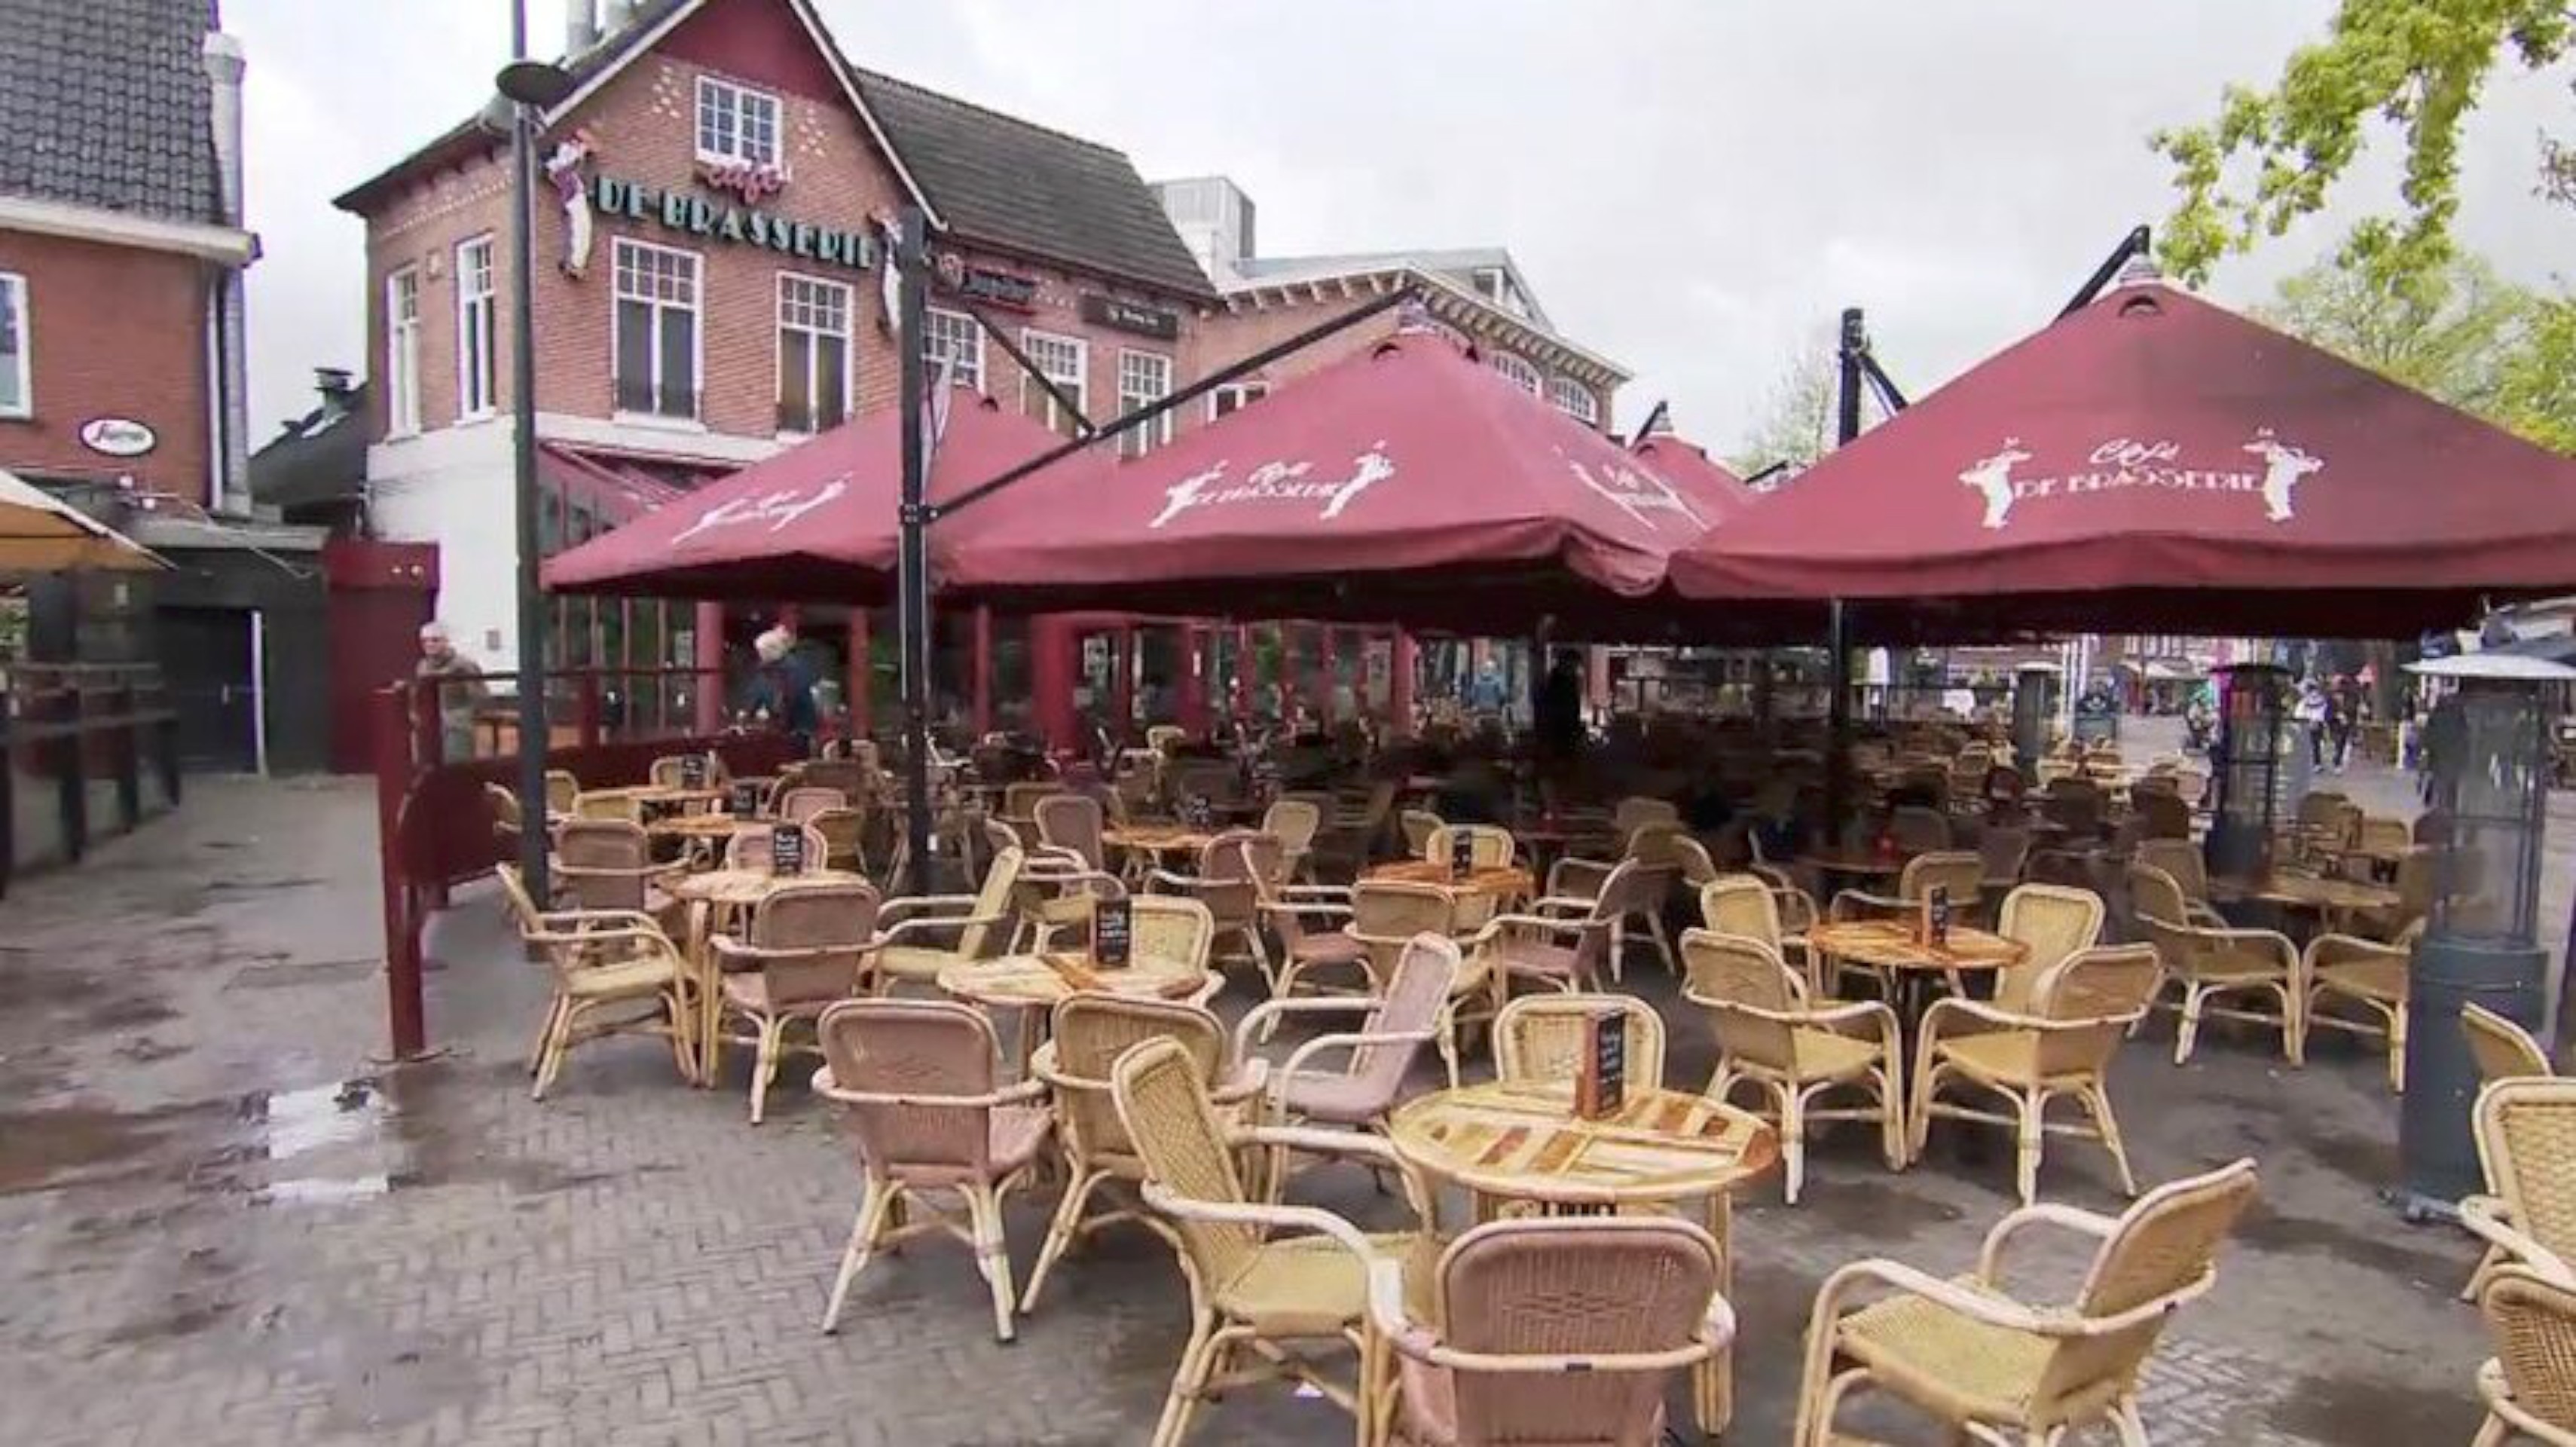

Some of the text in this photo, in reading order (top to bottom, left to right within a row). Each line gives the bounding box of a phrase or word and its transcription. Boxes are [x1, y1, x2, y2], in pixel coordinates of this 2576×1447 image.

[594, 176, 879, 270] DE BRASSERIE
[2014, 465, 2262, 498] DE BRASSERIE
